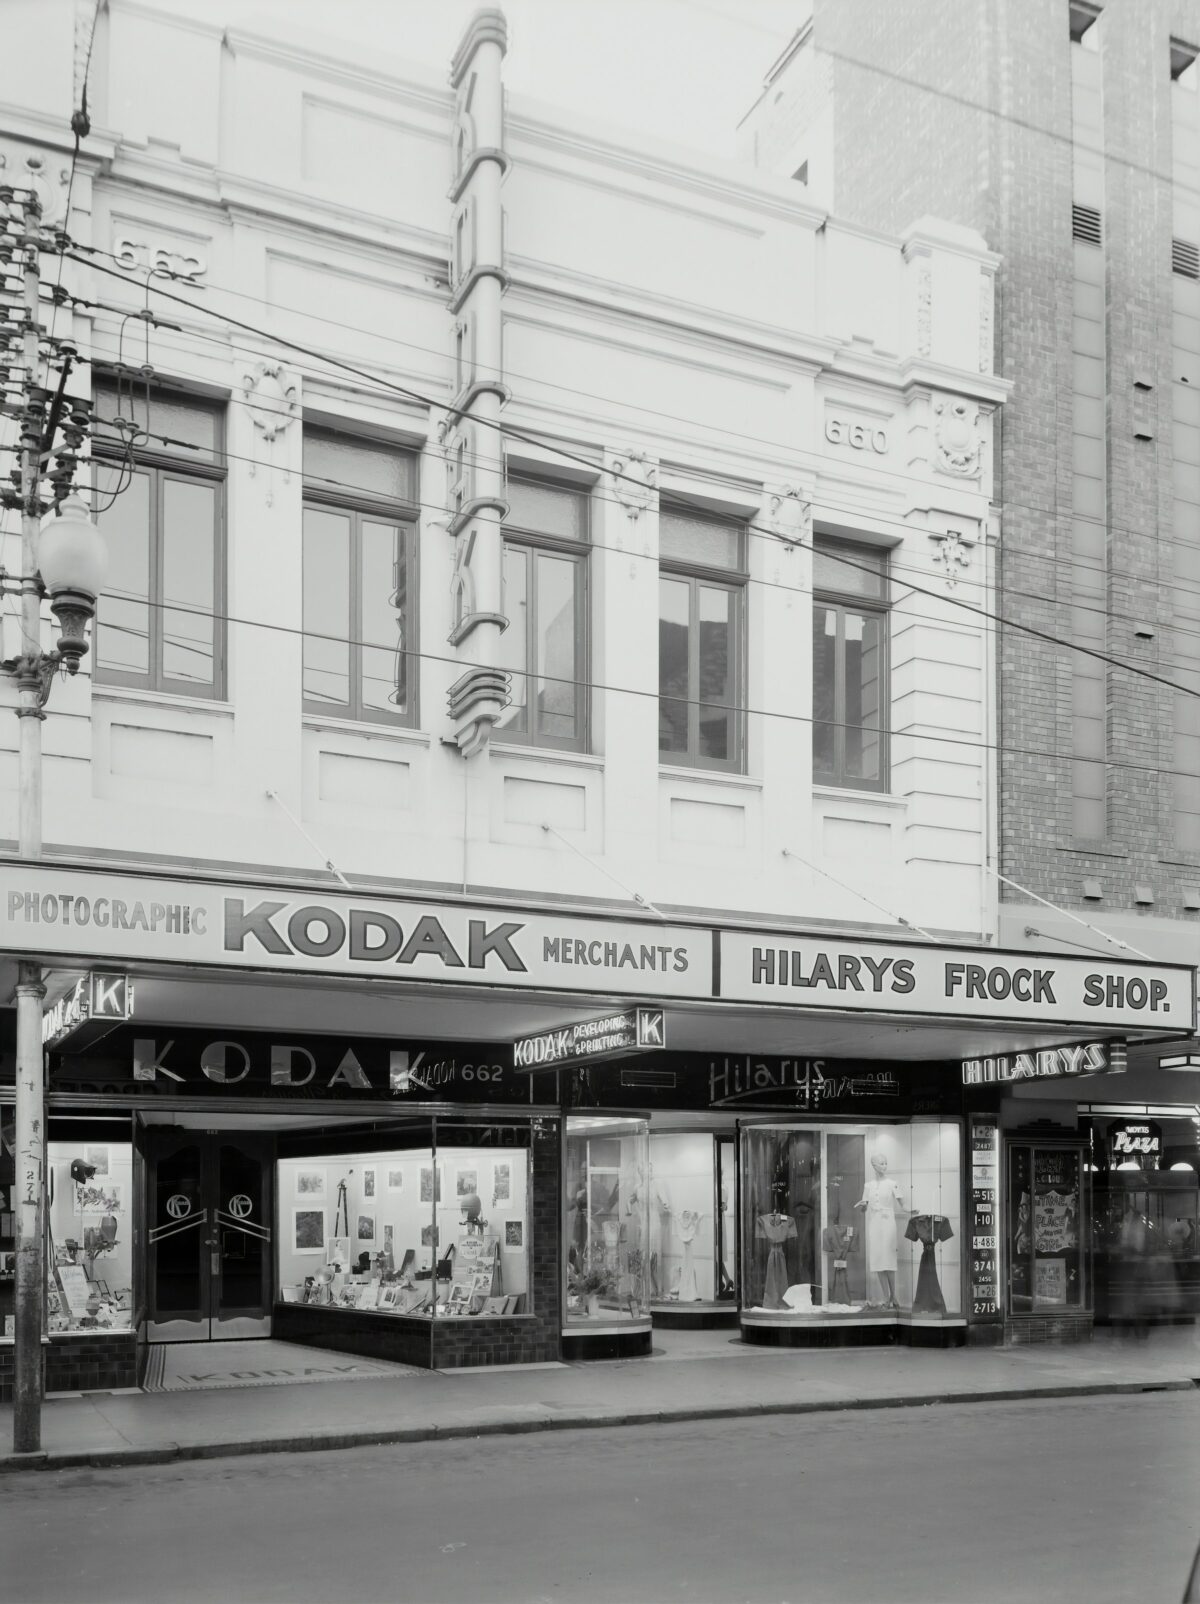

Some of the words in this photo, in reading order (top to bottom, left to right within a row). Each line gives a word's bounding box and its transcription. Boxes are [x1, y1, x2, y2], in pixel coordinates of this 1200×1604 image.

[114, 238, 207, 290] 662
[824, 418, 889, 455] 660
[8, 890, 207, 935] PHOTOGRAPHIC
[222, 897, 529, 972] KODAK
[543, 936, 689, 973] MERCHANTS
[95, 977, 123, 1016] K
[752, 947, 916, 994] HILARYS
[945, 963, 1057, 1004] FROCK
[1083, 974, 1171, 1014] SHOP.
[573, 1015, 627, 1038] DEVELOPING
[641, 1012, 662, 1044] K
[133, 1038, 437, 1091] KODAK
[461, 1063, 503, 1081] 662
[513, 1029, 569, 1066] KODAK
[962, 1043, 1107, 1084] HILARYS
[708, 1056, 825, 1101] Hilarys
[1113, 1131, 1159, 1154] PLAZA
[981, 1190, 995, 1200] 513
[974, 1261, 995, 1271] 3741
